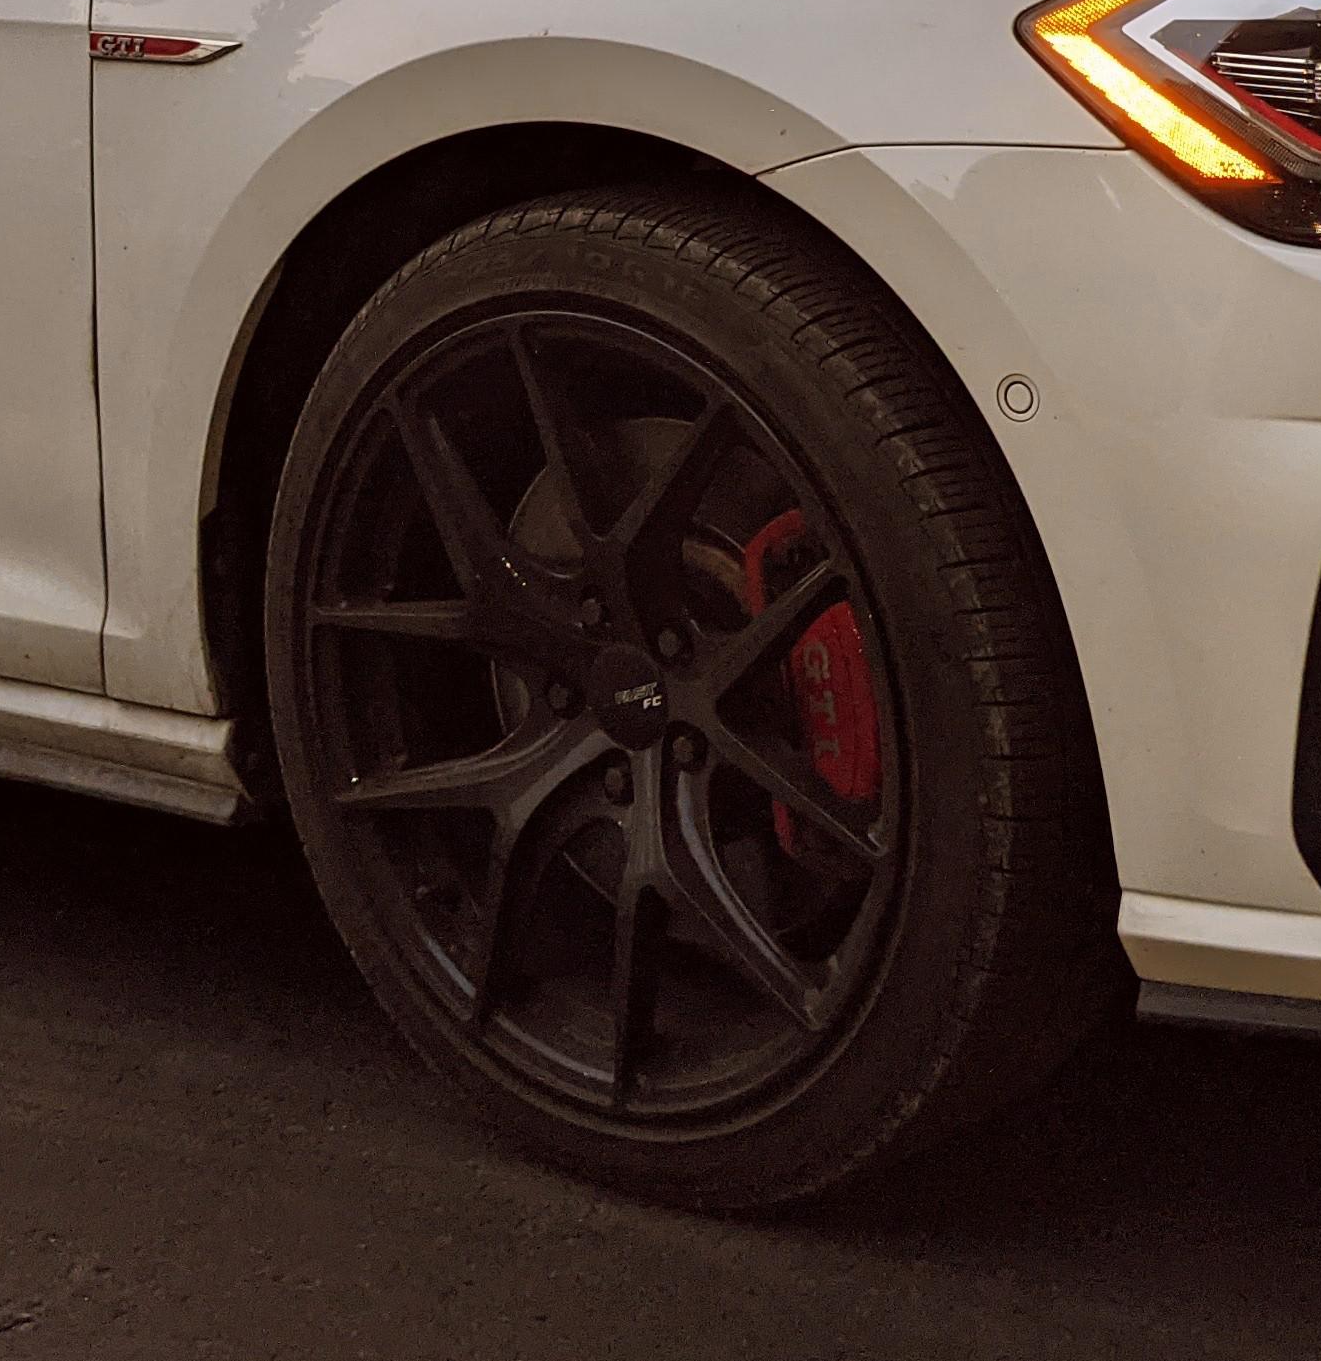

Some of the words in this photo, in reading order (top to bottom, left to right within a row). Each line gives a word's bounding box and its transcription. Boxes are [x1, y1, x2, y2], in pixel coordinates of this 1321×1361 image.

[96, 35, 145, 58] GTI
[643, 695, 662, 709] FC
[802, 640, 840, 759] GTI
